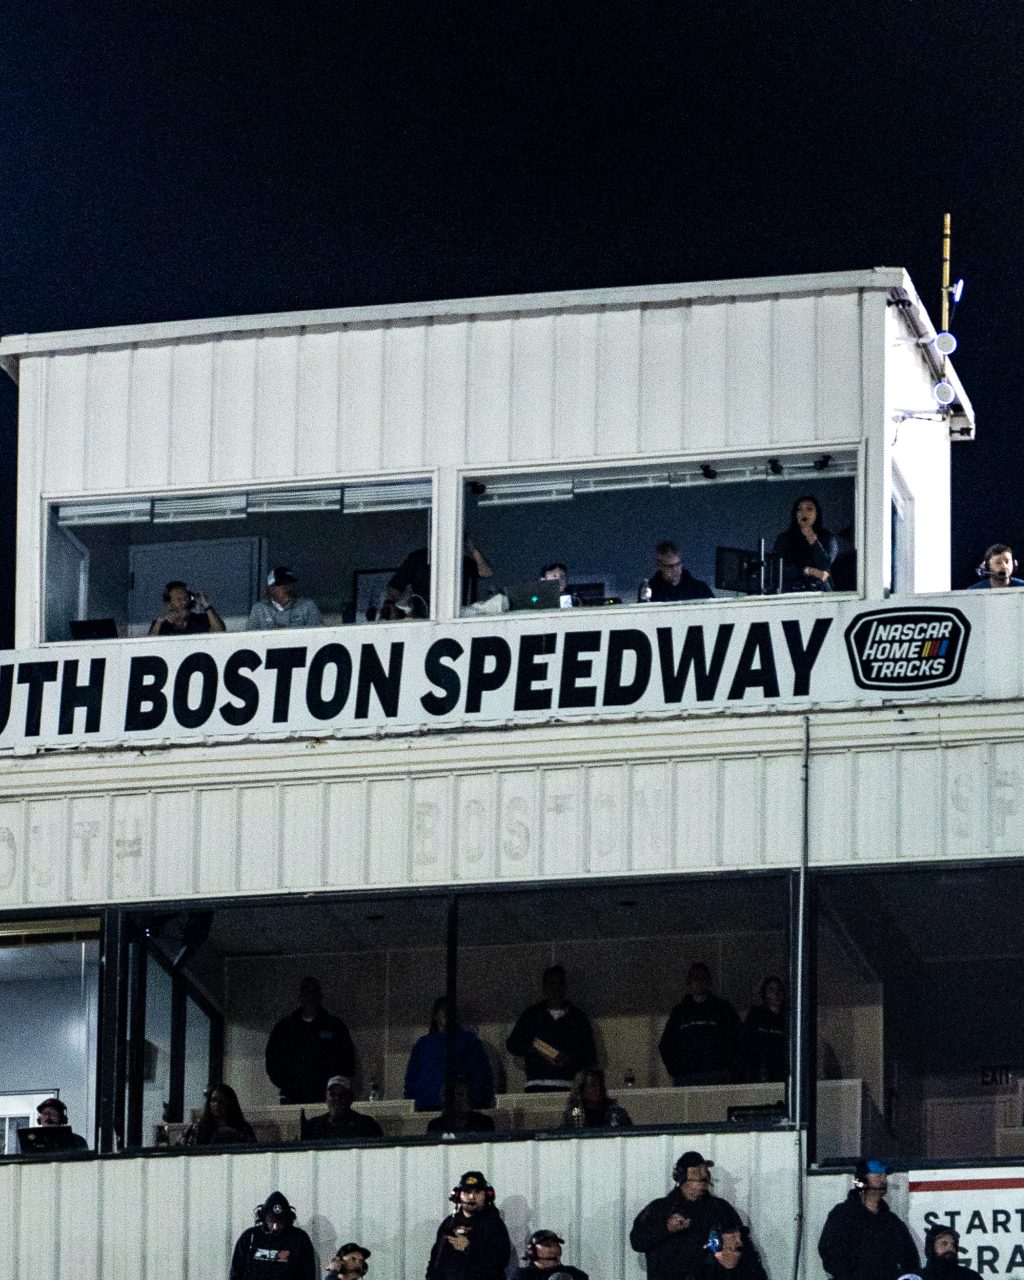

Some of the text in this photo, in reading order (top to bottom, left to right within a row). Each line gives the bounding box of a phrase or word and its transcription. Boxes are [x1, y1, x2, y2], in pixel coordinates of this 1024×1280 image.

[874, 621, 953, 641] NASCAR
[124, 642, 405, 732] BOSTON
[420, 617, 833, 717] SPEEDWAY
[871, 658, 946, 678] TRACKS
